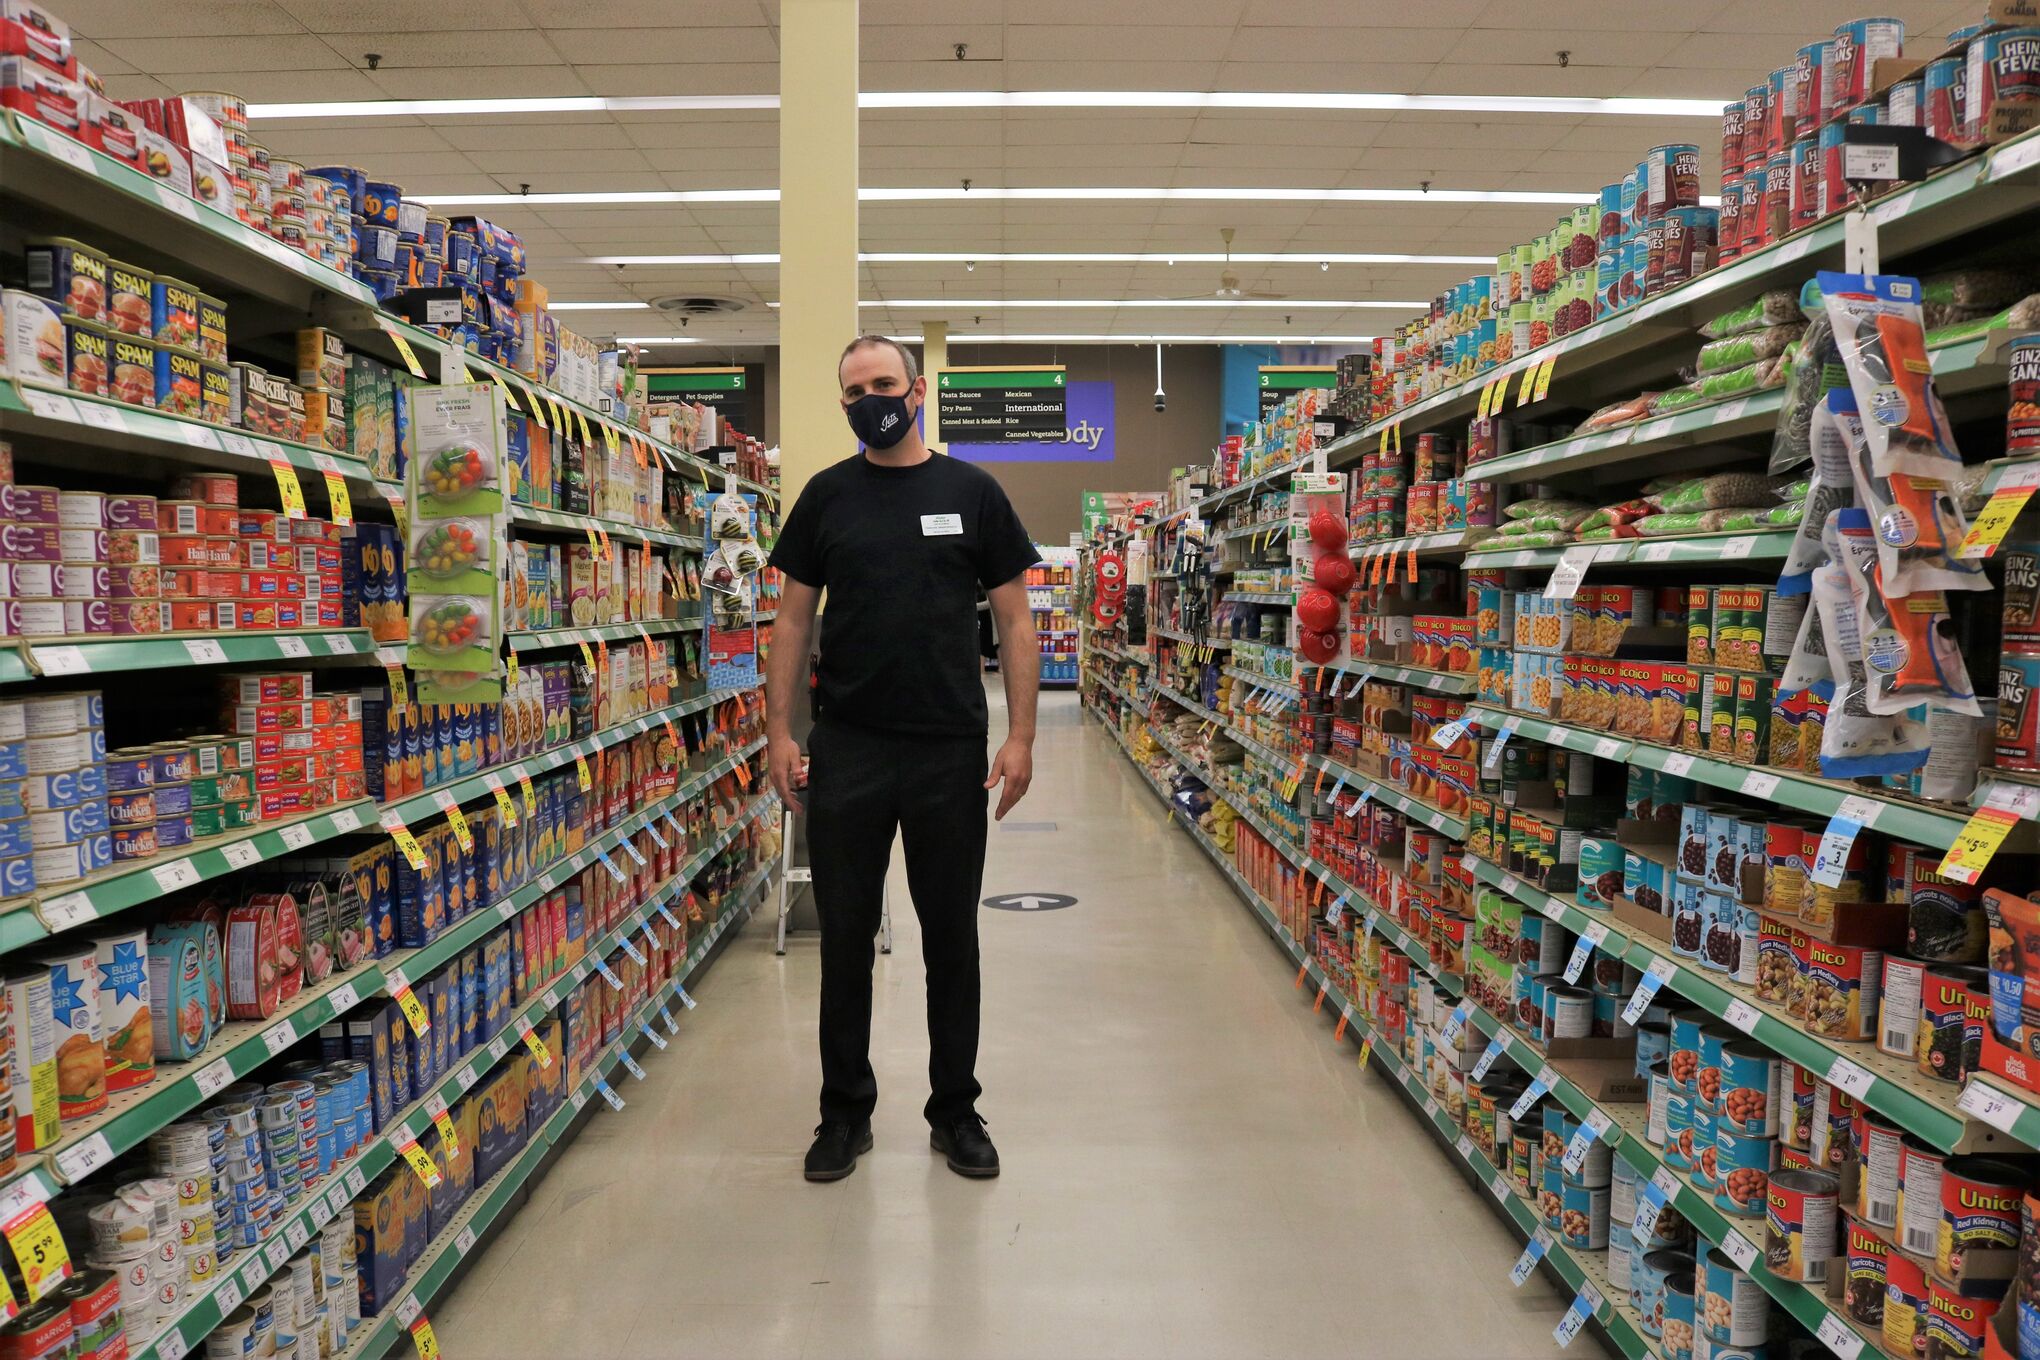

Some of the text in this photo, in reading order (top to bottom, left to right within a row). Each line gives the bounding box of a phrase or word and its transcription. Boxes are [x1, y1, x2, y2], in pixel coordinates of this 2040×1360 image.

[2004, 41, 2040, 57] HEIN
[1999, 55, 2040, 75] FEVE
[72, 252, 106, 282] SPAM
[113, 271, 151, 298] SPAM
[167, 287, 197, 312] SPAM
[202, 308, 226, 330] SPAM
[75, 332, 107, 357] SPAM
[116, 343, 154, 367] SPAM
[171, 355, 200, 378] SPAM
[206, 372, 229, 391] SPAM
[733, 377, 741, 387] 5
[941, 374, 1063, 386] 4 4
[1262, 375, 1269, 386] 3
[697, 393, 724, 402] Supplies
[1262, 391, 1279, 399] Soup
[1005, 403, 1063, 412] International
[880, 412, 899, 432] Jets
[1030, 430, 1064, 439] Vegetables
[2005, 556, 2032, 571] EINZ
[2004, 571, 2039, 588] EANS
